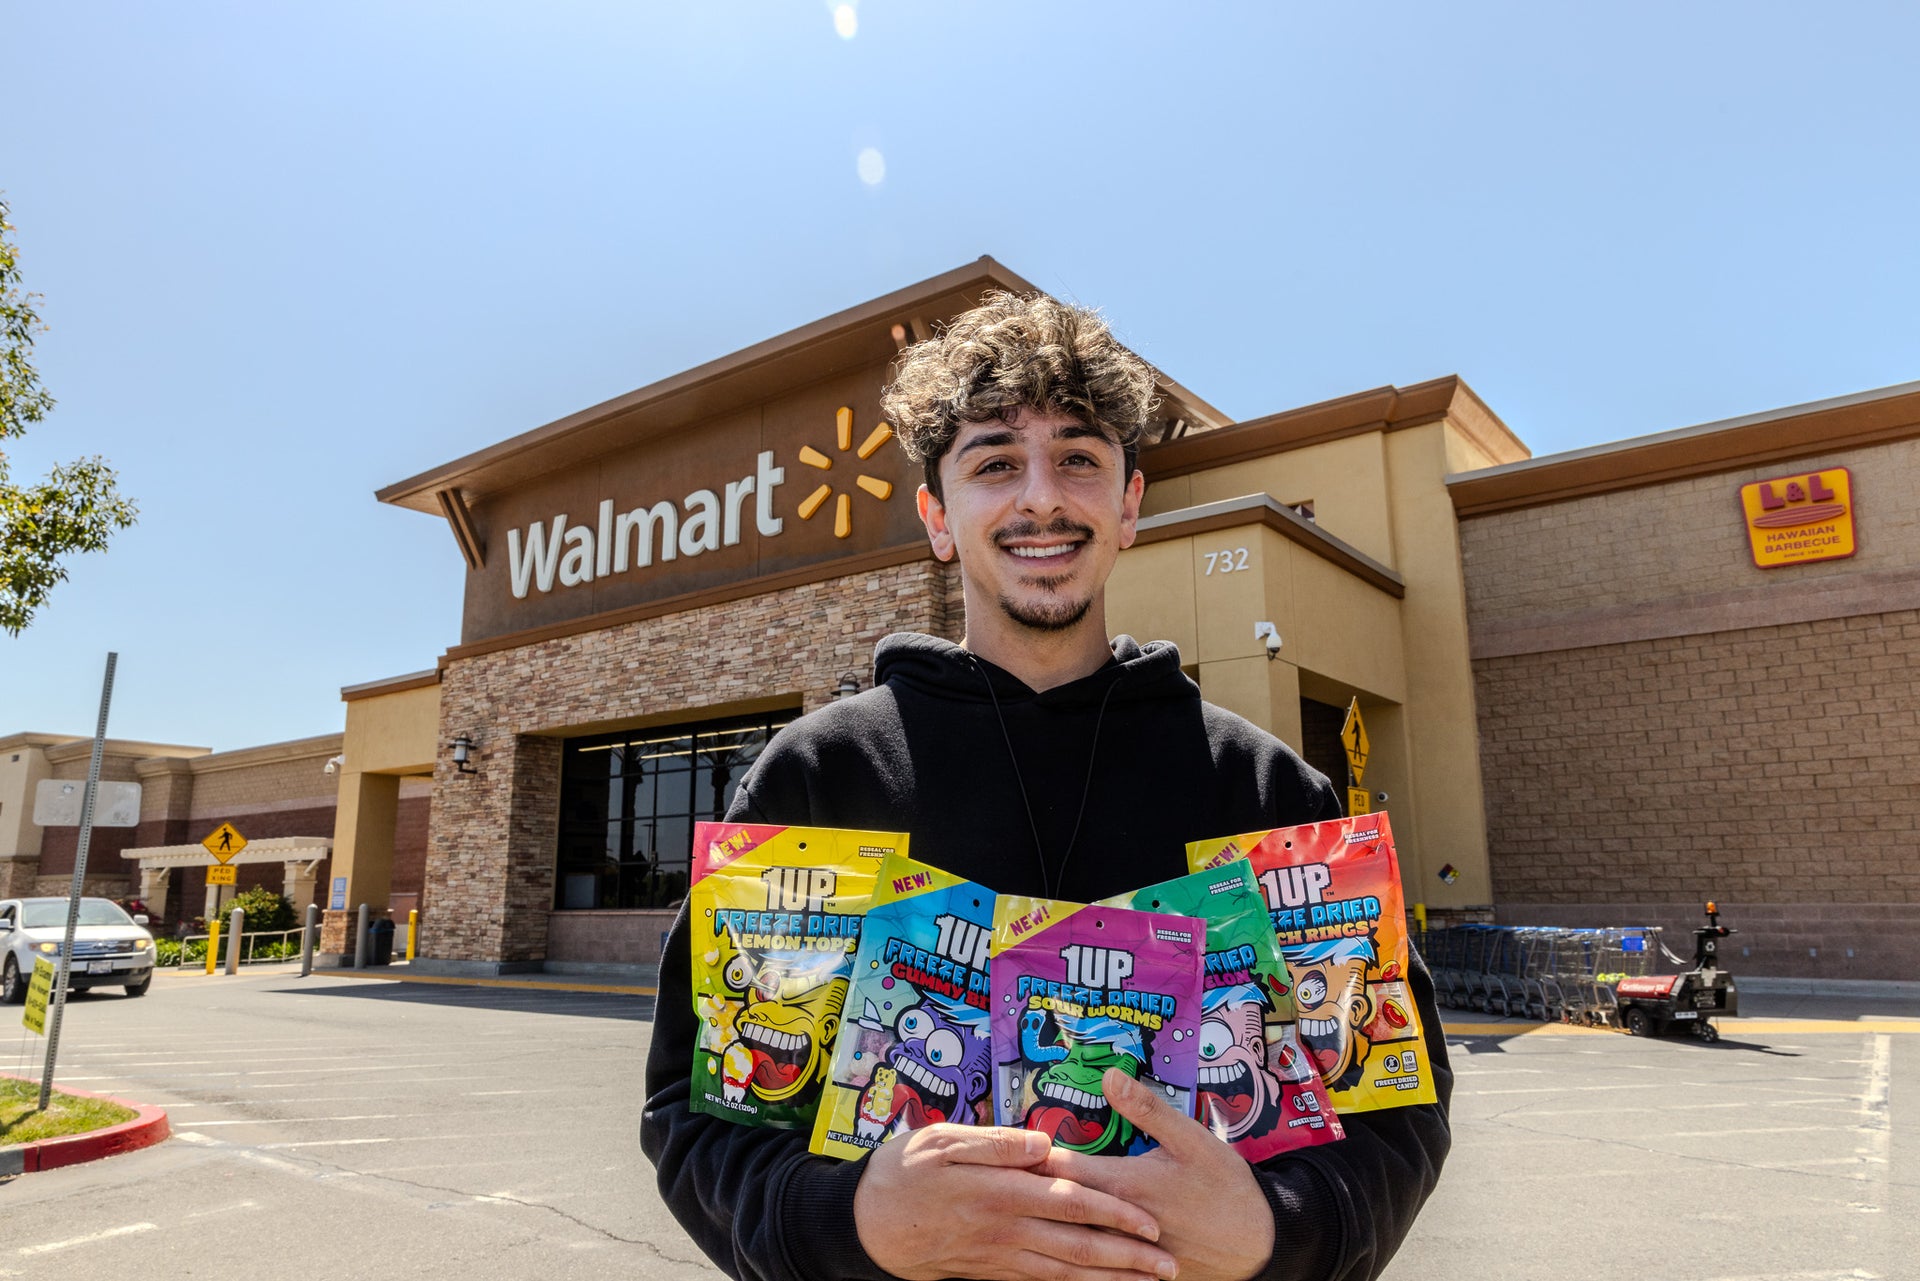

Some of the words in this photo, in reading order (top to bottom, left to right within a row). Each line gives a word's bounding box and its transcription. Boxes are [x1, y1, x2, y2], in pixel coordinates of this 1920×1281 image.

[1759, 475, 1834, 510] L&L
[507, 450, 785, 599] Walmart
[1767, 525, 1835, 542] HAWAIIAN
[1765, 536, 1841, 553] BARBECUE
[1204, 547, 1249, 576] 732
[1355, 794, 1364, 806] PED
[710, 829, 752, 864] NEW!
[762, 867, 836, 912] 1UP
[892, 871, 932, 894] NEW!
[1259, 863, 1331, 910] 1UP
[715, 909, 803, 937] FREEZE
[807, 914, 867, 937] DRIE
[1009, 906, 1051, 937] NEW!
[1311, 897, 1380, 927] DRIED
[732, 933, 801, 950] LEMON
[804, 936, 857, 953] TOPS
[1305, 921, 1370, 943] RINGS
[884, 938, 967, 989] FREEZE
[1060, 944, 1134, 990] 1UP
[1204, 945, 1256, 975] RIED
[892, 962, 964, 999] GUMMY
[1018, 976, 1103, 1005] FREEZE
[1109, 991, 1176, 1020] DRIED
[1028, 995, 1084, 1018] SOUR
[1087, 1005, 1163, 1030] WORMS
[1397, 1081, 1418, 1090] CANDY
[705, 1093, 715, 1101] NET
[731, 1102, 738, 1110] OZ
[738, 1104, 758, 1115] (120g)
[827, 1130, 841, 1140] NET
[842, 1134, 853, 1143] WT
[853, 1137, 864, 1146] 2.0
[864, 1140, 874, 1149] OZ
